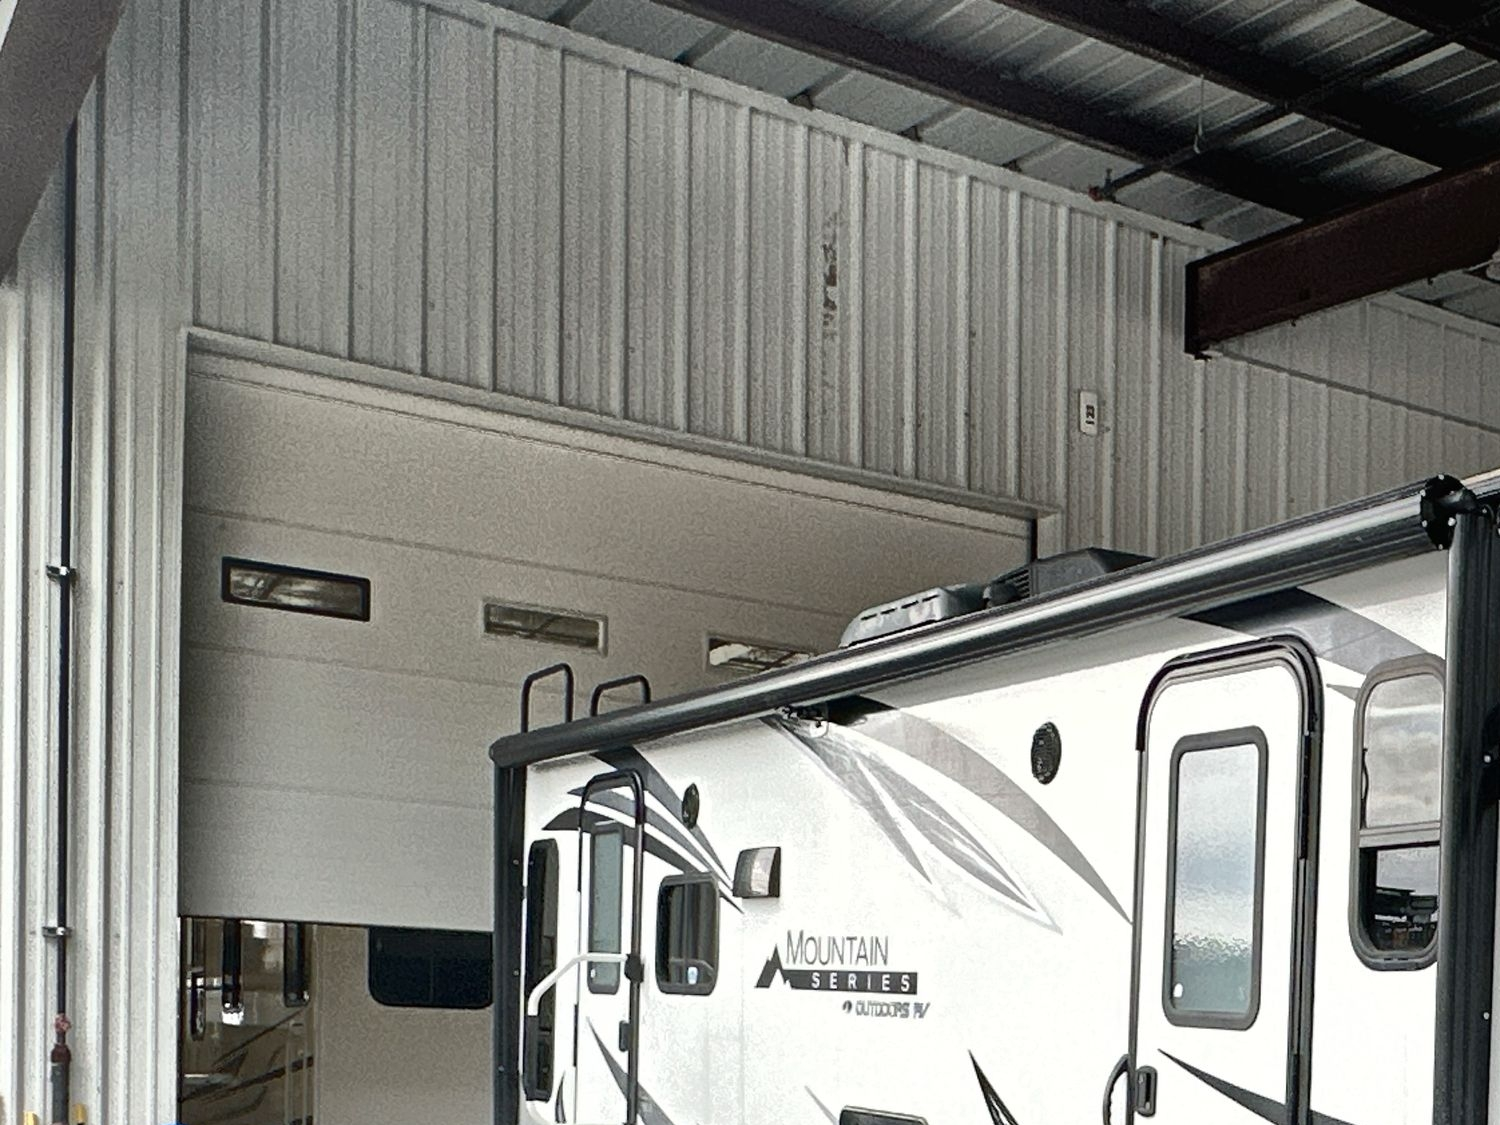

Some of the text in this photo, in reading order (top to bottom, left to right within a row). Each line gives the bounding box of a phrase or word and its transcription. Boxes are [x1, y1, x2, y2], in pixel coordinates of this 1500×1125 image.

[786, 929, 889, 967] MOUNTAIN
[811, 971, 911, 992] SERIES
[855, 1000, 931, 1020] OUTDOORS RV
